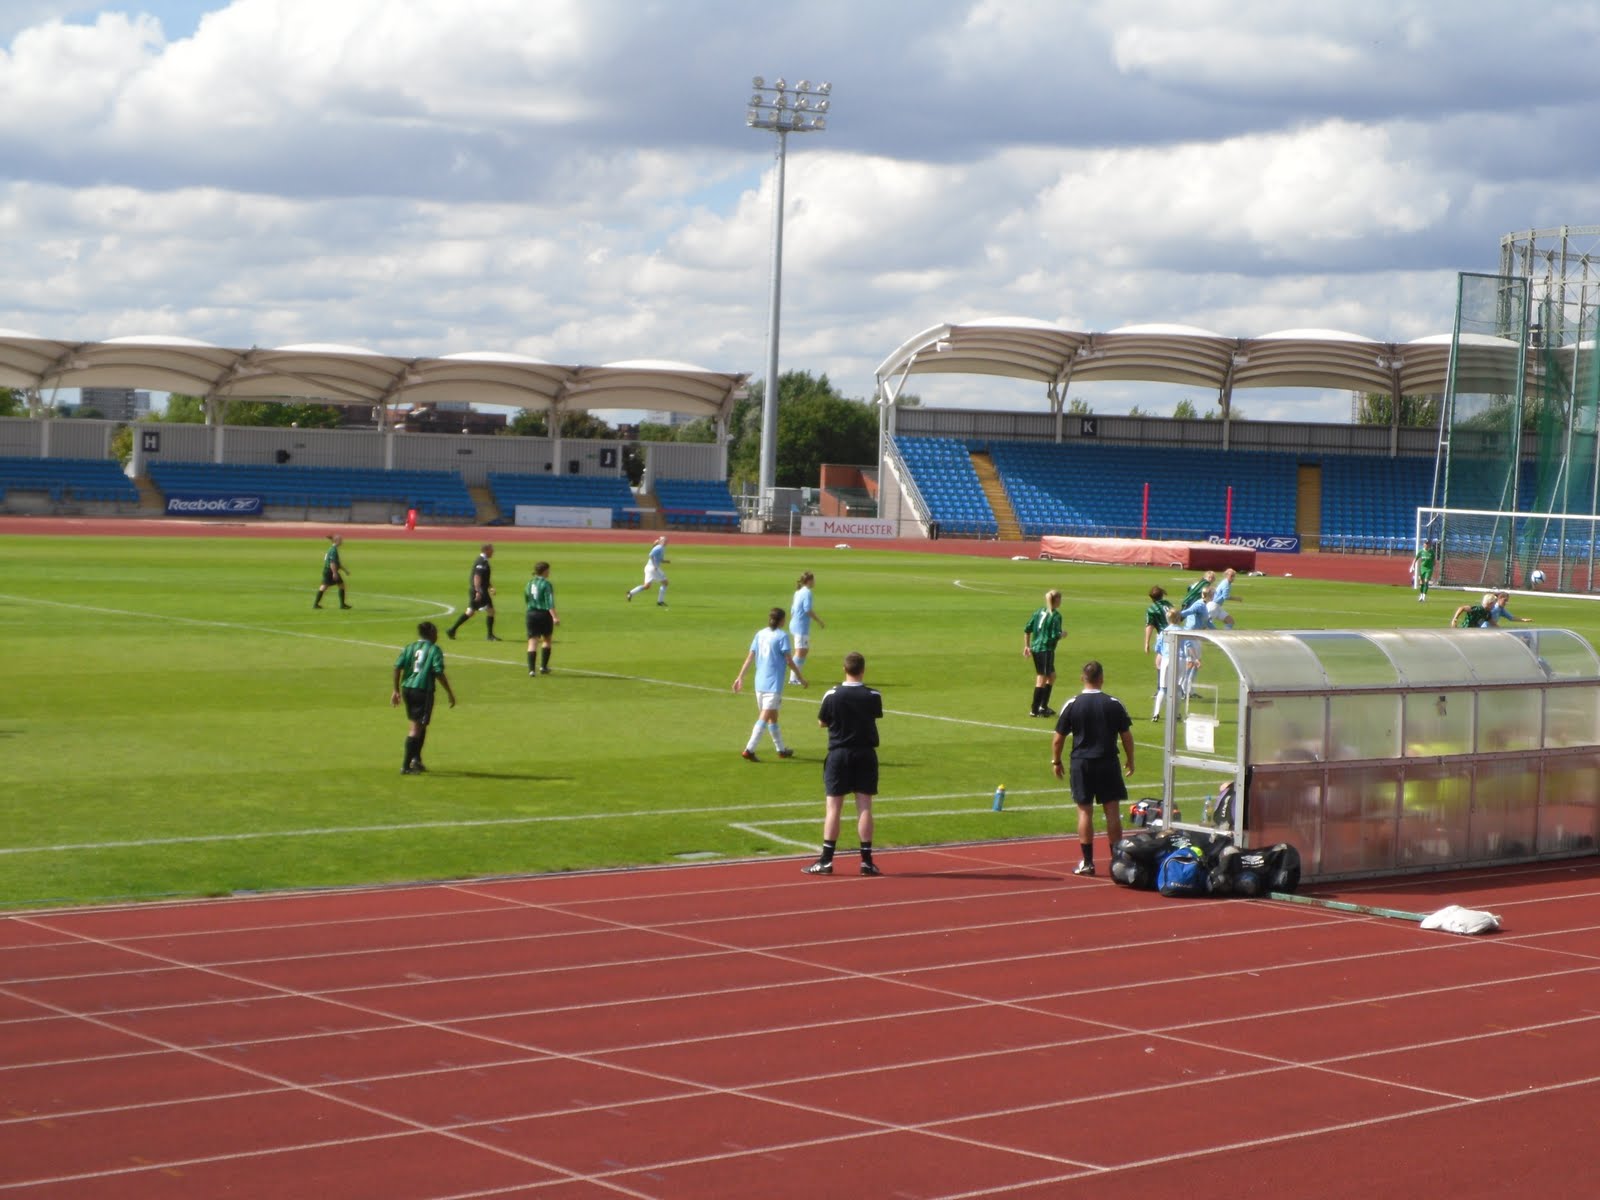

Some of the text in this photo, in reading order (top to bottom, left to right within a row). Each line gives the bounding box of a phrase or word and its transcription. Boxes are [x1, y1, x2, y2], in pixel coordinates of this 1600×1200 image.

[1084, 420, 1094, 433] K
[144, 435, 156, 449] H
[604, 452, 611, 465] J
[167, 498, 228, 511] Reebok
[823, 521, 893, 536] MANCHESTER
[1038, 610, 1047, 629] 7
